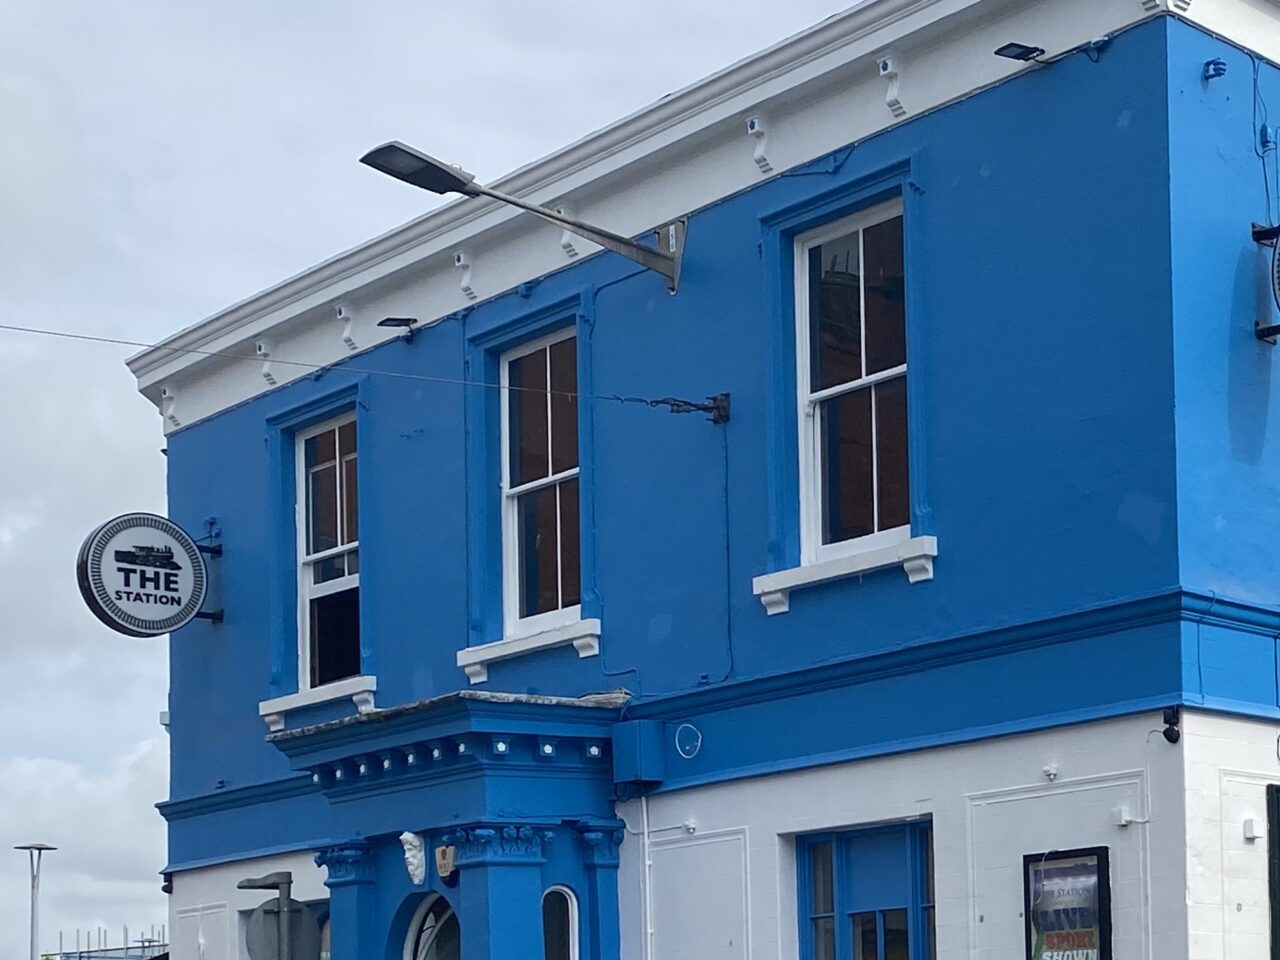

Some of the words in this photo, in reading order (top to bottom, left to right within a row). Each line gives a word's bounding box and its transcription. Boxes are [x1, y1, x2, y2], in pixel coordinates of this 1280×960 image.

[117, 567, 179, 593] THE
[114, 590, 182, 607] STATION
[1040, 907, 1092, 931] LIVE
